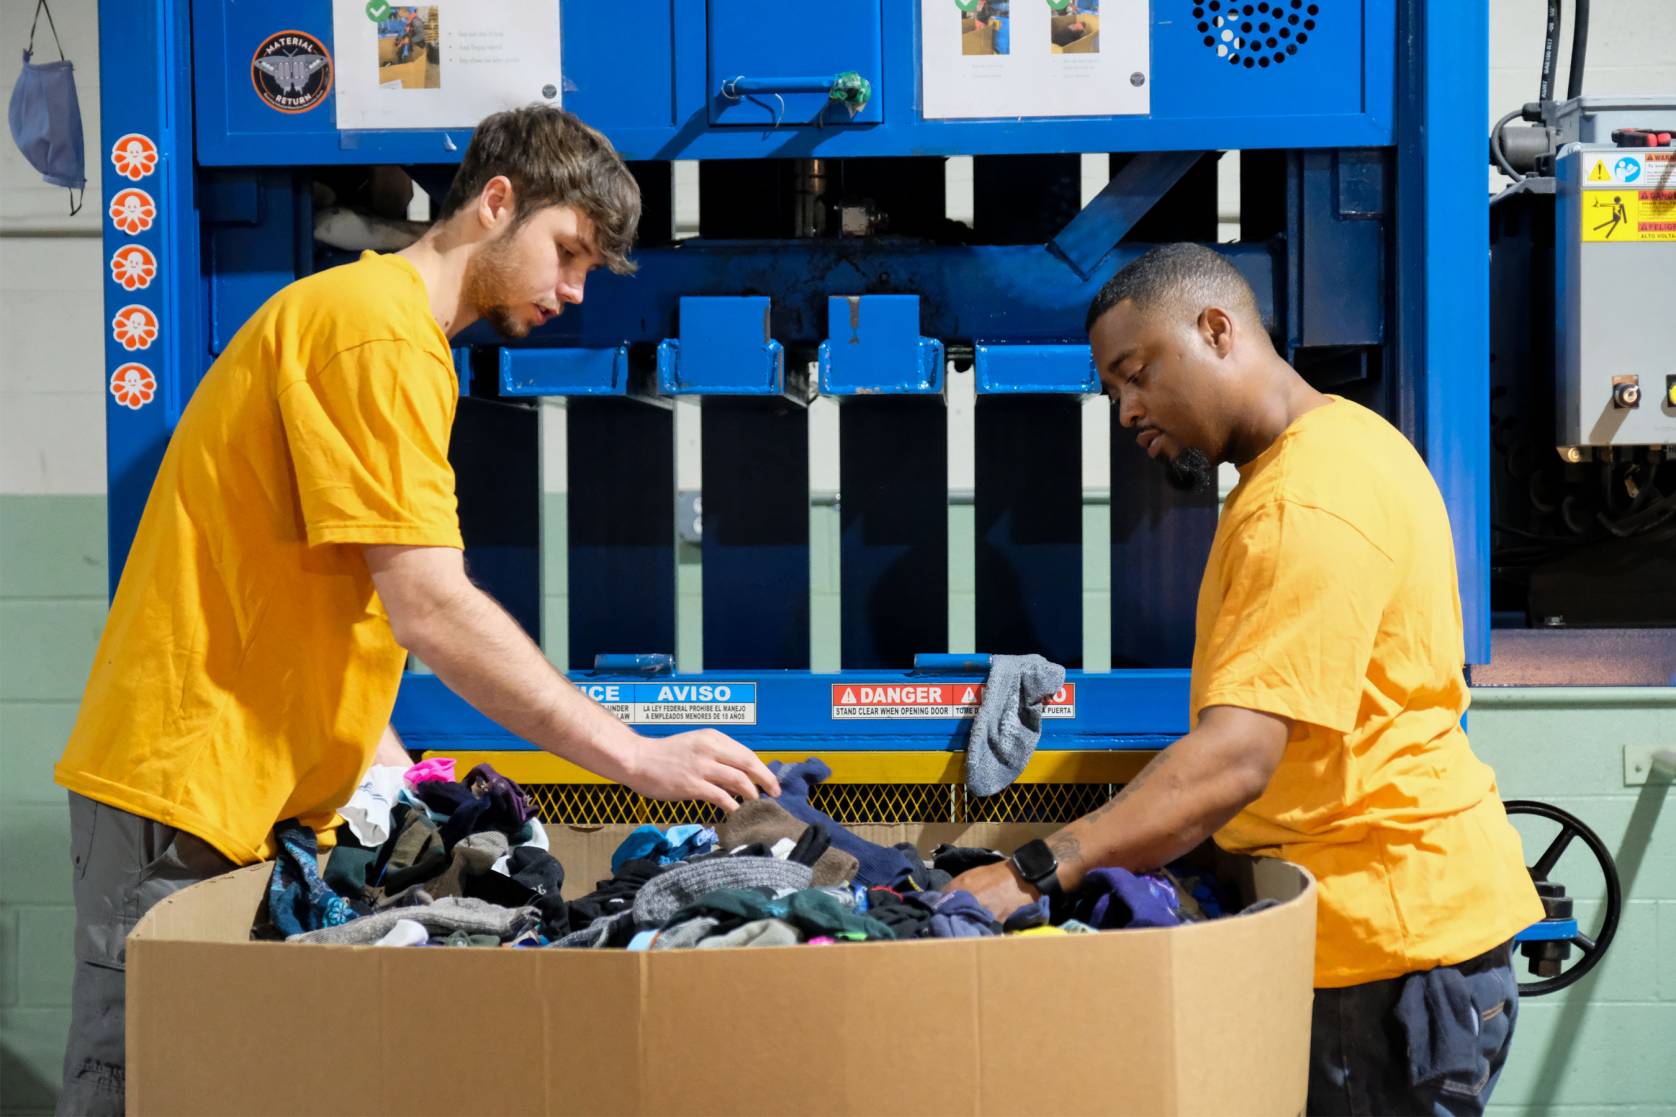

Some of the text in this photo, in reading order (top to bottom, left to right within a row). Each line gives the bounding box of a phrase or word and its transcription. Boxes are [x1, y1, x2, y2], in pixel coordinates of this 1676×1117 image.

[266, 37, 314, 54] MATERIAL
[275, 93, 312, 105] RETURN
[657, 686, 731, 702] AVISO
[860, 687, 942, 703] DANGER
[836, 707, 949, 715] STAND CLEAR WHEN OPENING DOOR
